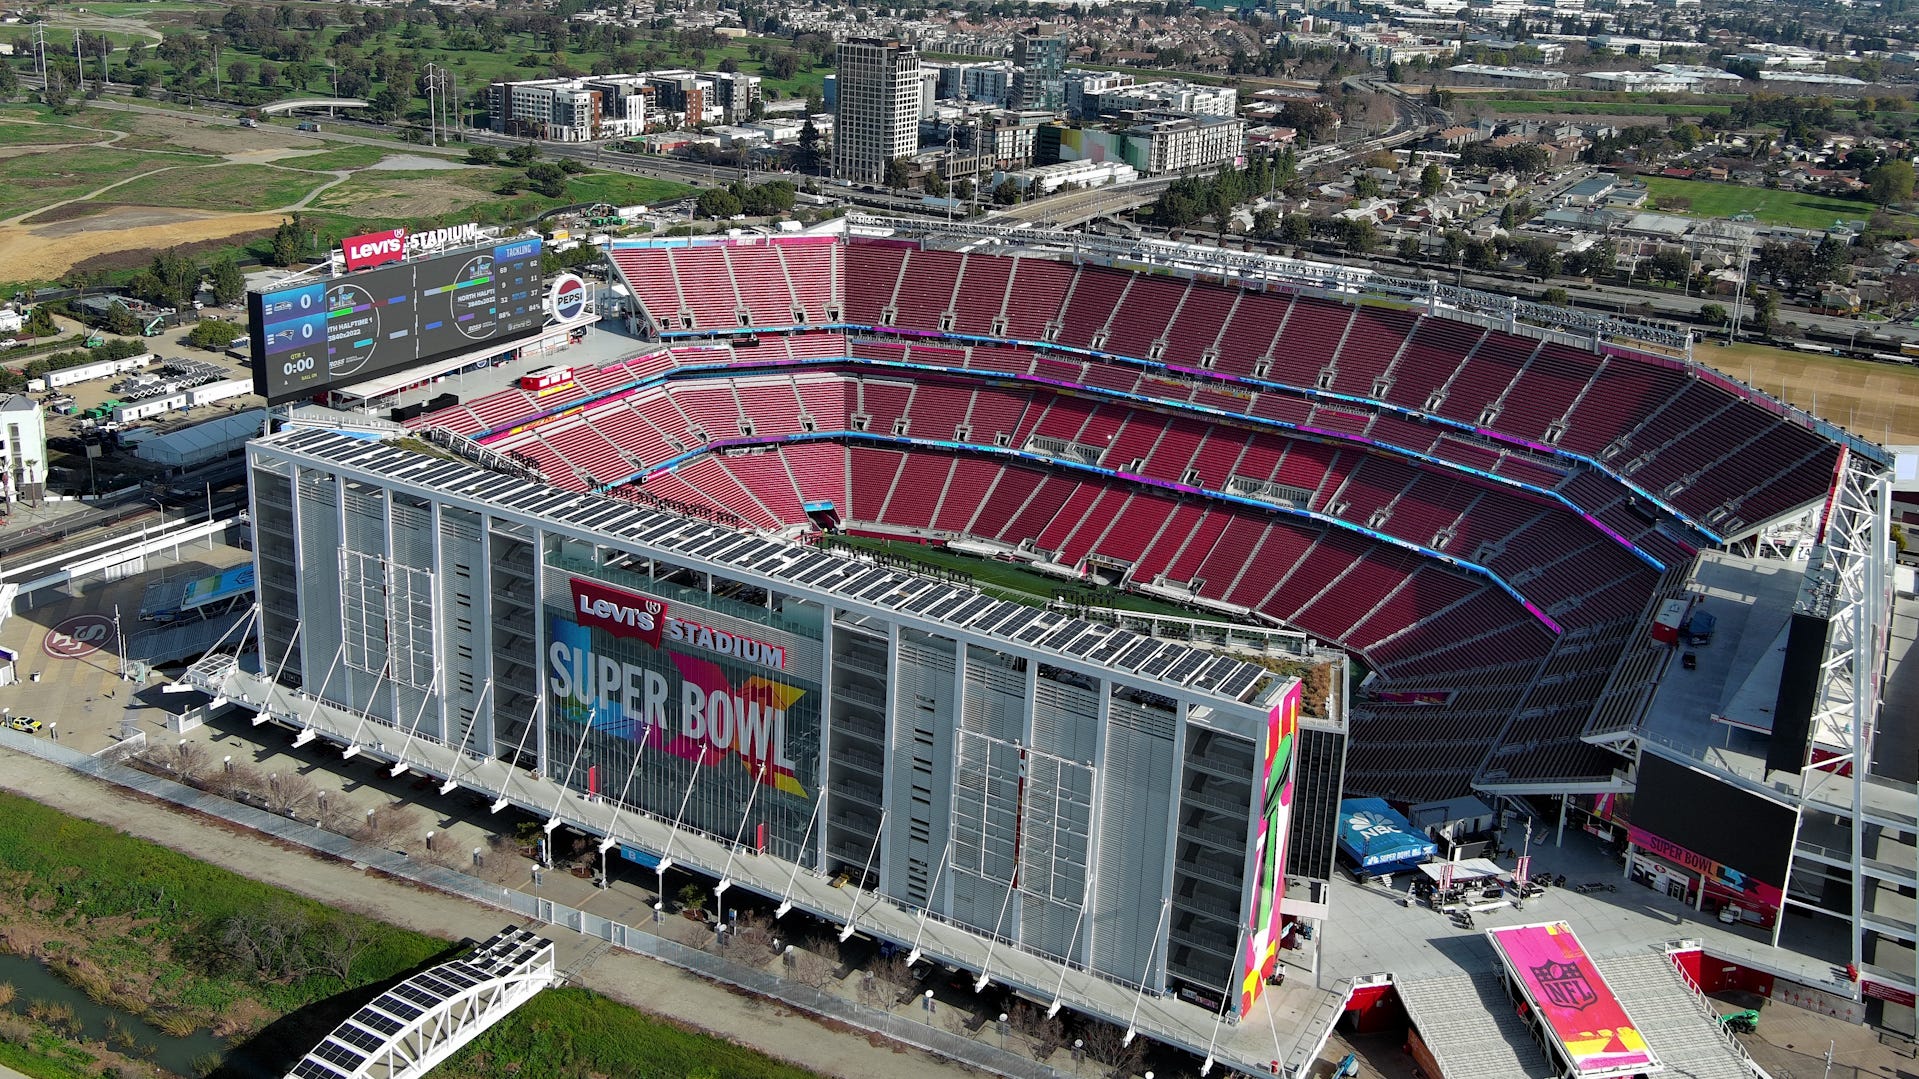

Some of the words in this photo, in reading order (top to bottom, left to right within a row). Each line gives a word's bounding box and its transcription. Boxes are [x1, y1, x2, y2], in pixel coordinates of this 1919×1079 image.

[410, 222, 478, 249] STADIUM
[506, 244, 532, 258] TACKLING
[300, 294, 312, 309] 0
[458, 293, 476, 302] NORTH
[557, 292, 583, 306] PEPSI
[302, 324, 312, 338] 0
[338, 318, 369, 330] HALFTIME
[284, 356, 314, 376] 0:00
[670, 618, 785, 670] STADIUM
[549, 640, 668, 731] SUPER
[682, 680, 796, 772] BOWL
[1360, 824, 1403, 840] NBC
[1650, 836, 1683, 860] SUPER
[1684, 850, 1714, 876] BOWL
[1544, 980, 1593, 1005] NFL
